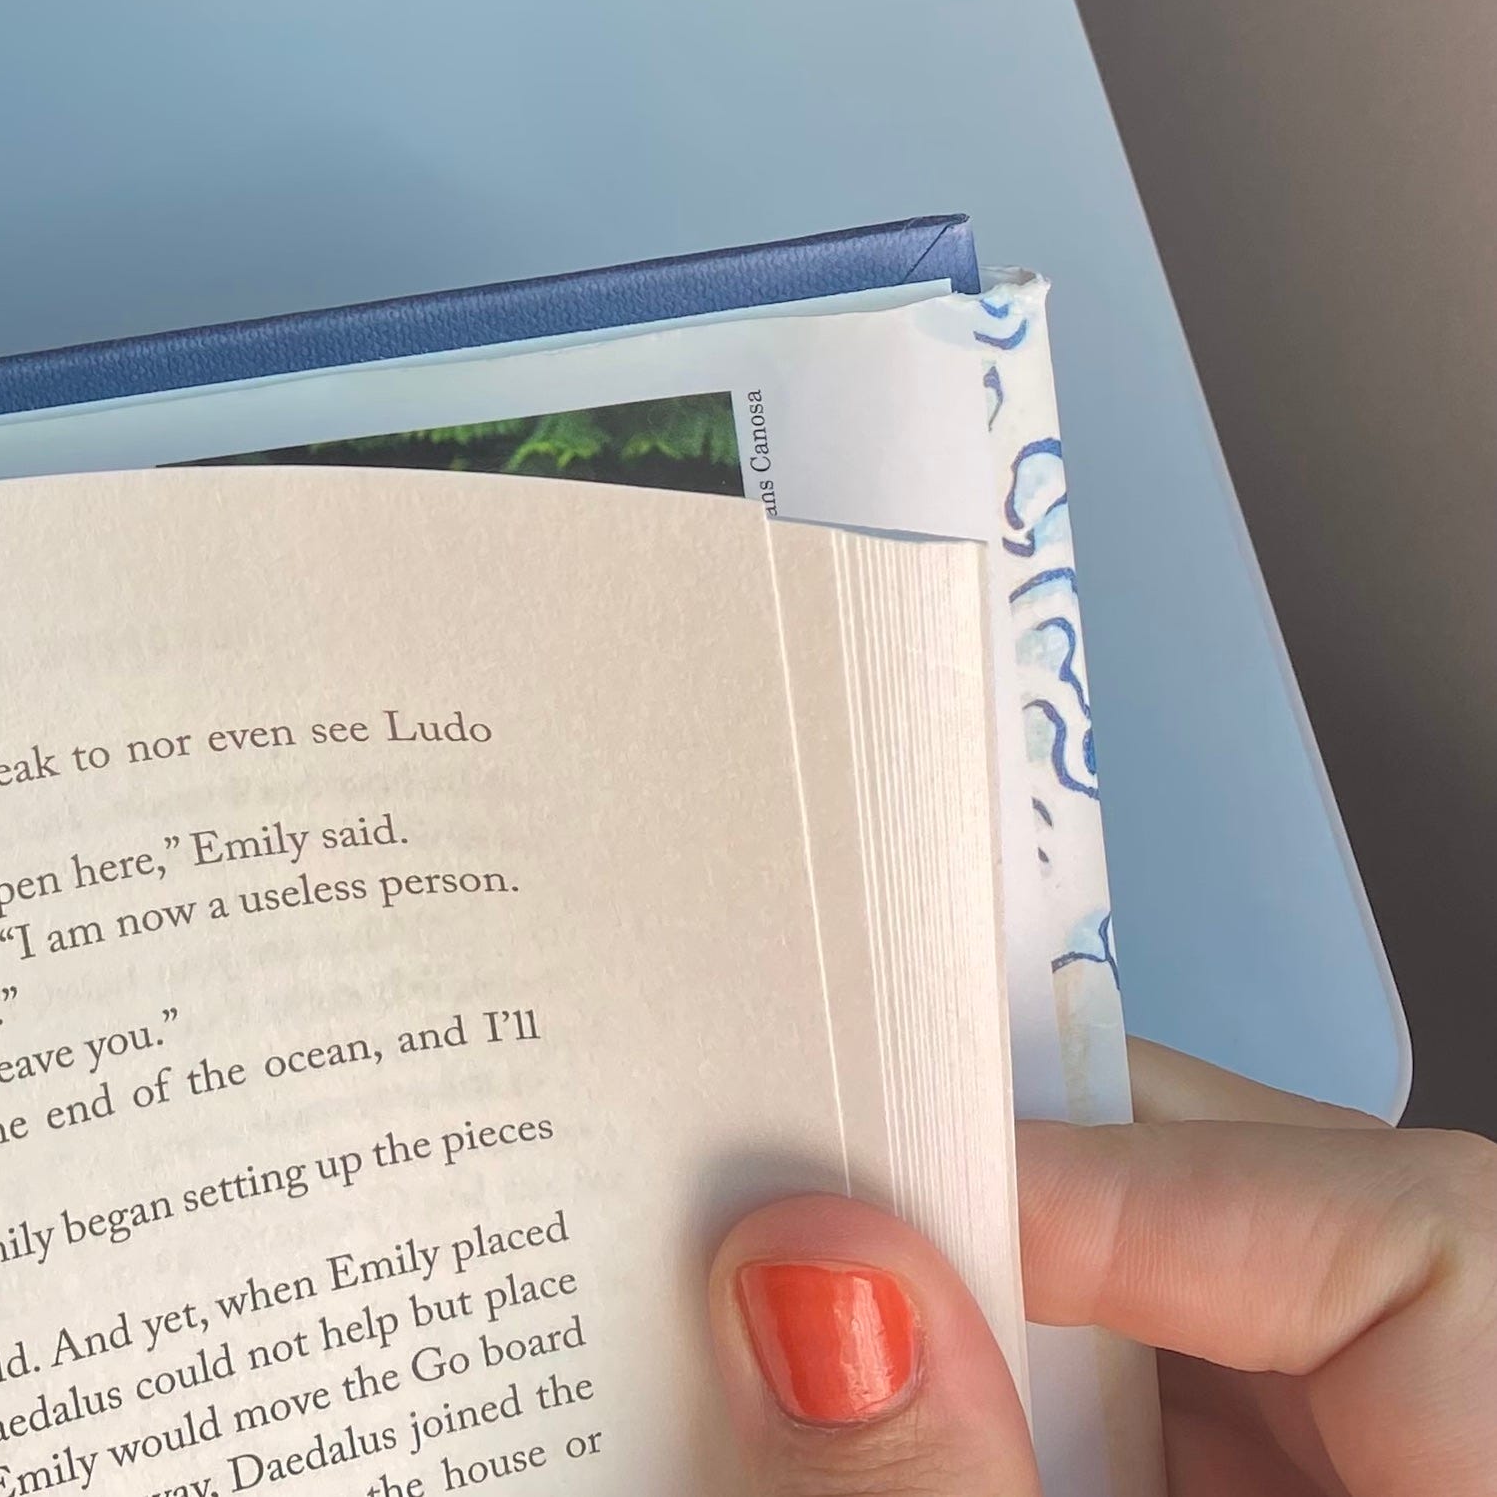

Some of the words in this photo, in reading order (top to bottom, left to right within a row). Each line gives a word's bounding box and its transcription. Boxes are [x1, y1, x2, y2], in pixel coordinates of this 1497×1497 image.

[747, 389, 771, 473] Canosa
[70, 745, 112, 773] to
[125, 733, 193, 765] nor
[206, 724, 298, 753] even
[310, 721, 371, 745] see
[381, 708, 493, 744] Ludo
[69, 834, 181, 890] here,”
[187, 820, 311, 868] Emily
[320, 811, 410, 850] said.
[46, 920, 107, 955] am
[115, 900, 199, 939] now
[236, 871, 368, 915] useless
[377, 872, 520, 910] person.
[45, 1080, 117, 1131] end
[131, 1065, 174, 1109] of
[185, 1056, 248, 1097] the
[263, 1038, 384, 1079] ocean,
[396, 1013, 470, 1055] and
[82, 1005, 179, 1076] you.”
[58, 1196, 176, 1246] began
[182, 1163, 310, 1214] setting
[313, 1151, 364, 1189] up
[370, 1130, 433, 1169] the
[439, 1118, 555, 1168] pieces
[49, 1310, 135, 1369] And
[140, 1302, 210, 1354] yet,
[212, 1275, 320, 1321] when
[324, 1236, 442, 1293] Emily
[449, 1208, 571, 1276] placed
[135, 1340, 238, 1402] could
[246, 1330, 312, 1372] not
[316, 1303, 400, 1353] help
[407, 1290, 475, 1329] but
[482, 1271, 579, 1324] place
[105, 1402, 225, 1469] would
[232, 1386, 333, 1434] move
[340, 1363, 402, 1403] the
[410, 1345, 471, 1383] Go
[477, 1313, 588, 1369] board
[225, 1423, 398, 1495] Daedalus
[408, 1381, 525, 1457] joined
[534, 1372, 595, 1411] the
[439, 1445, 548, 1493] house
[564, 1430, 603, 1460] or
